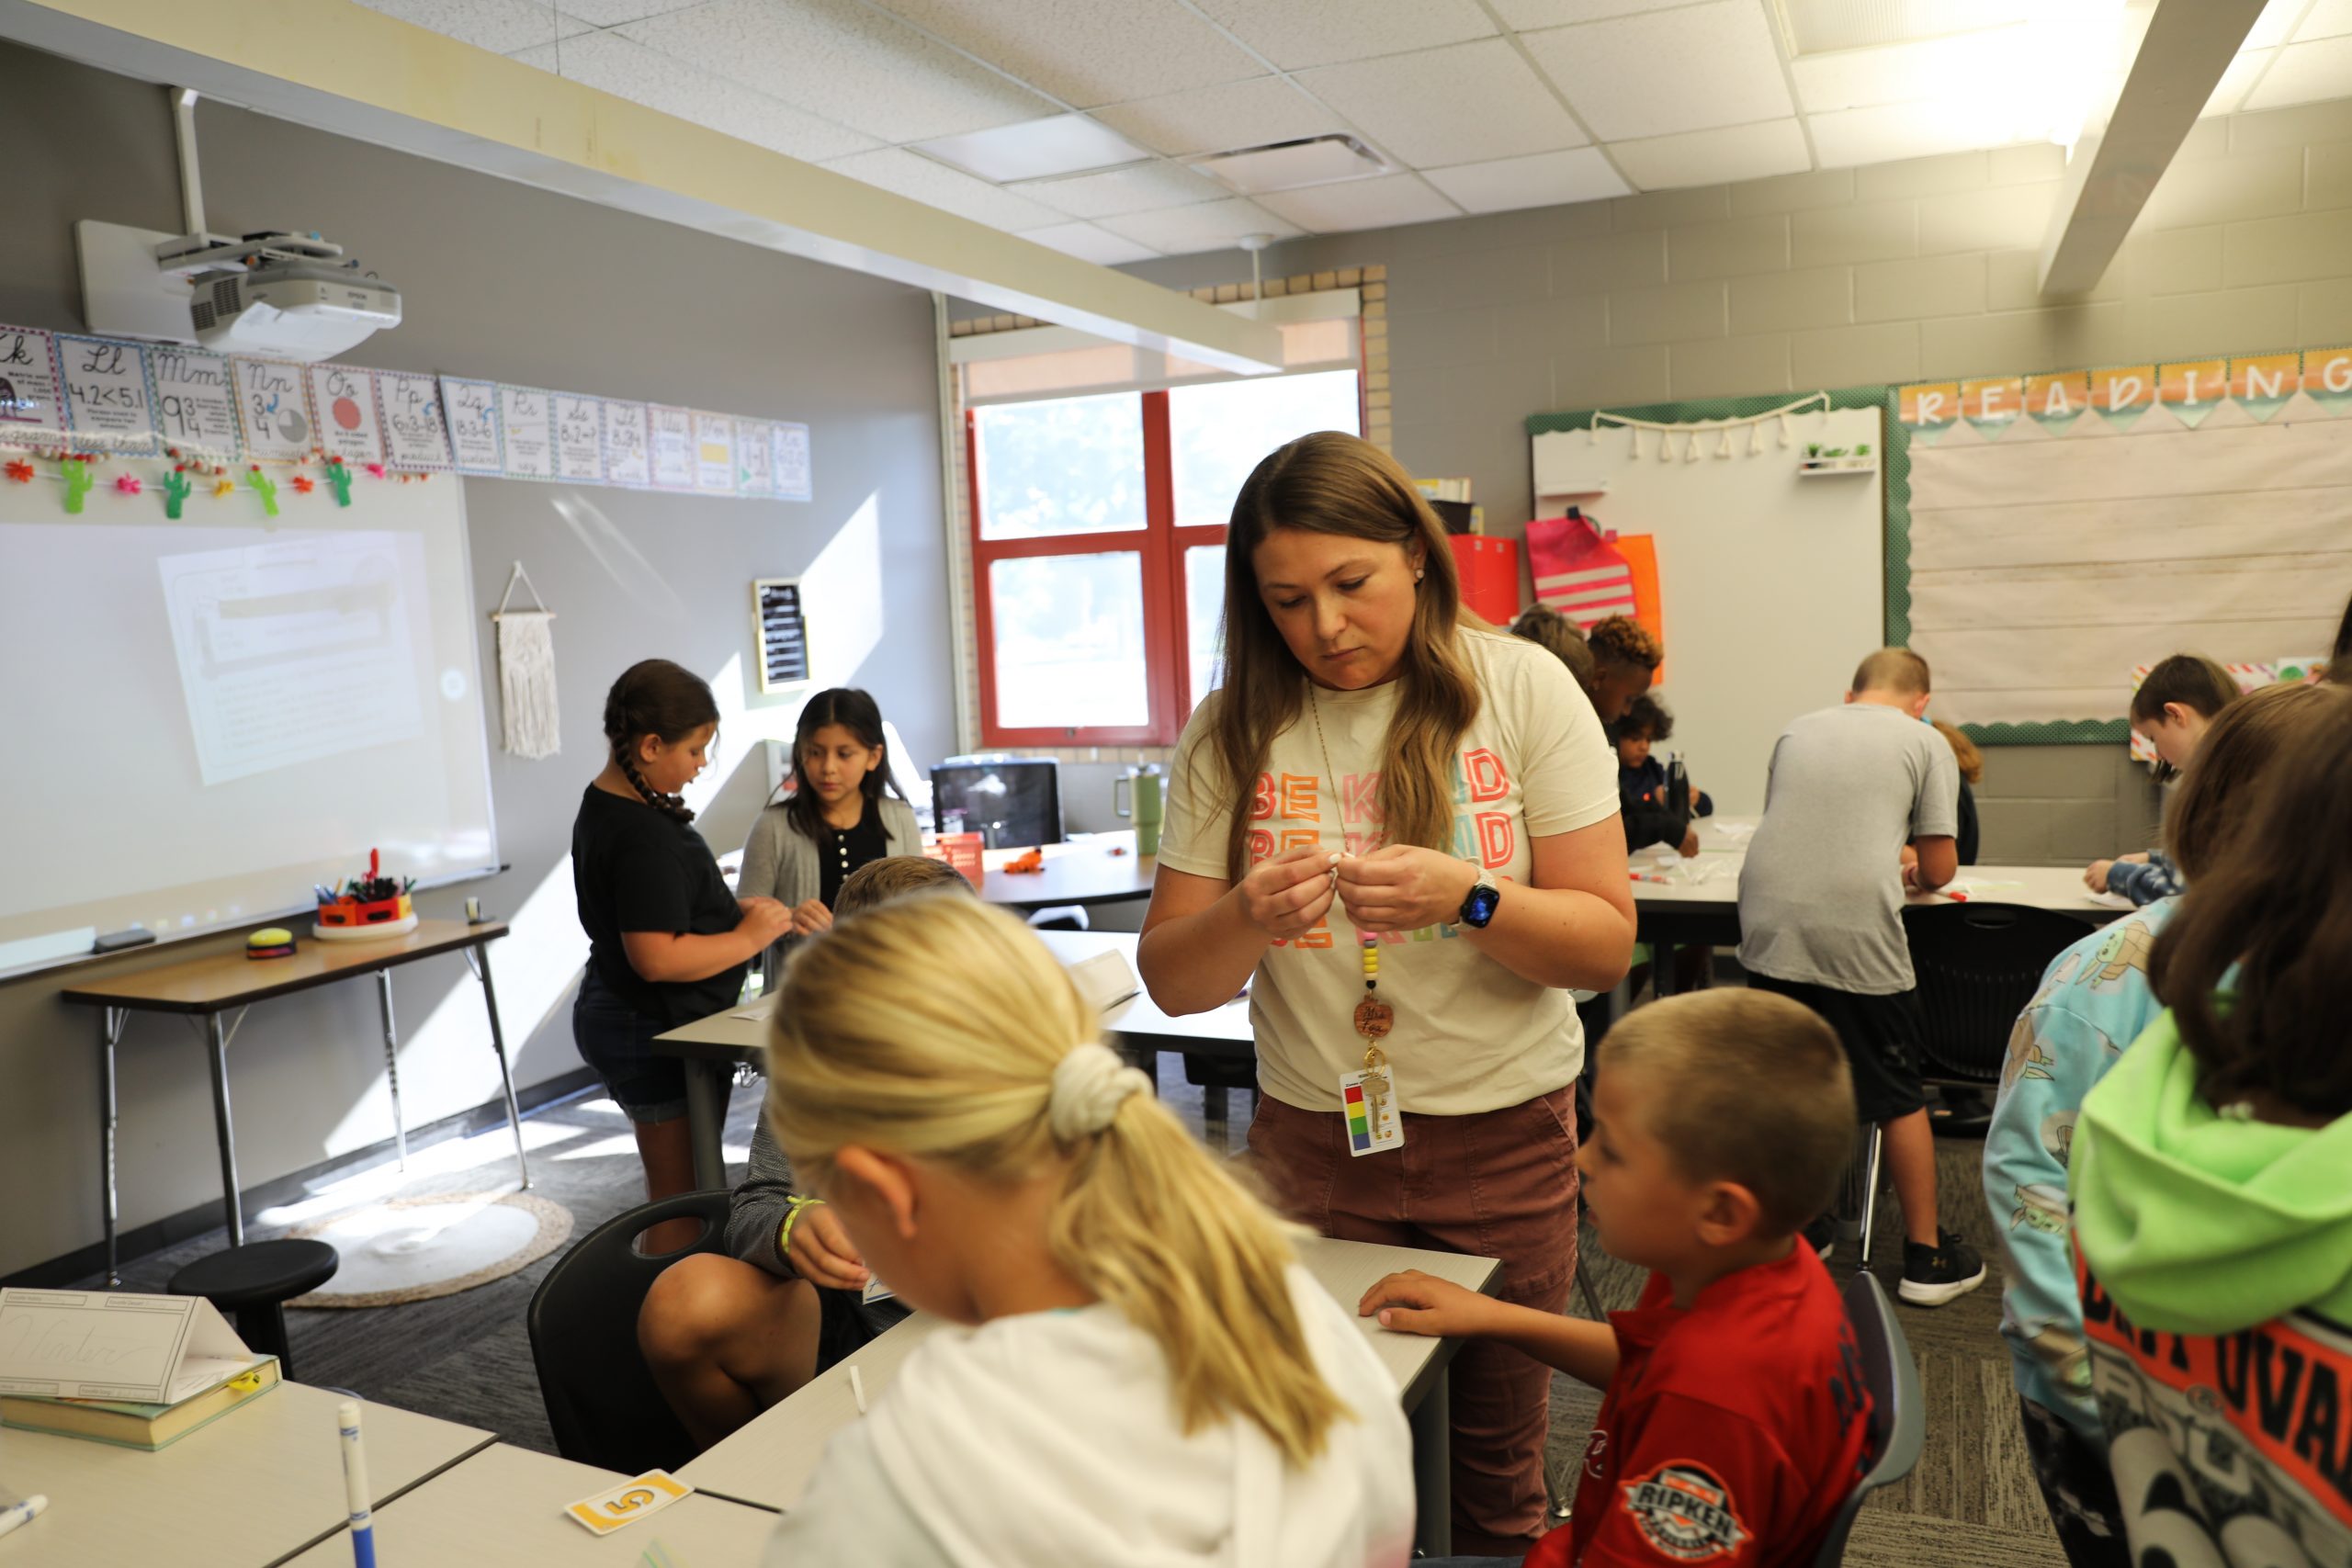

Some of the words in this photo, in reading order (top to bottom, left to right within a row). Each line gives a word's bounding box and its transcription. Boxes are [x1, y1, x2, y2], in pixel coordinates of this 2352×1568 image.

[1917, 355, 2352, 427] READING
[604, 1489, 655, 1516] 5
[1638, 1485, 1732, 1539] RIPKEN
